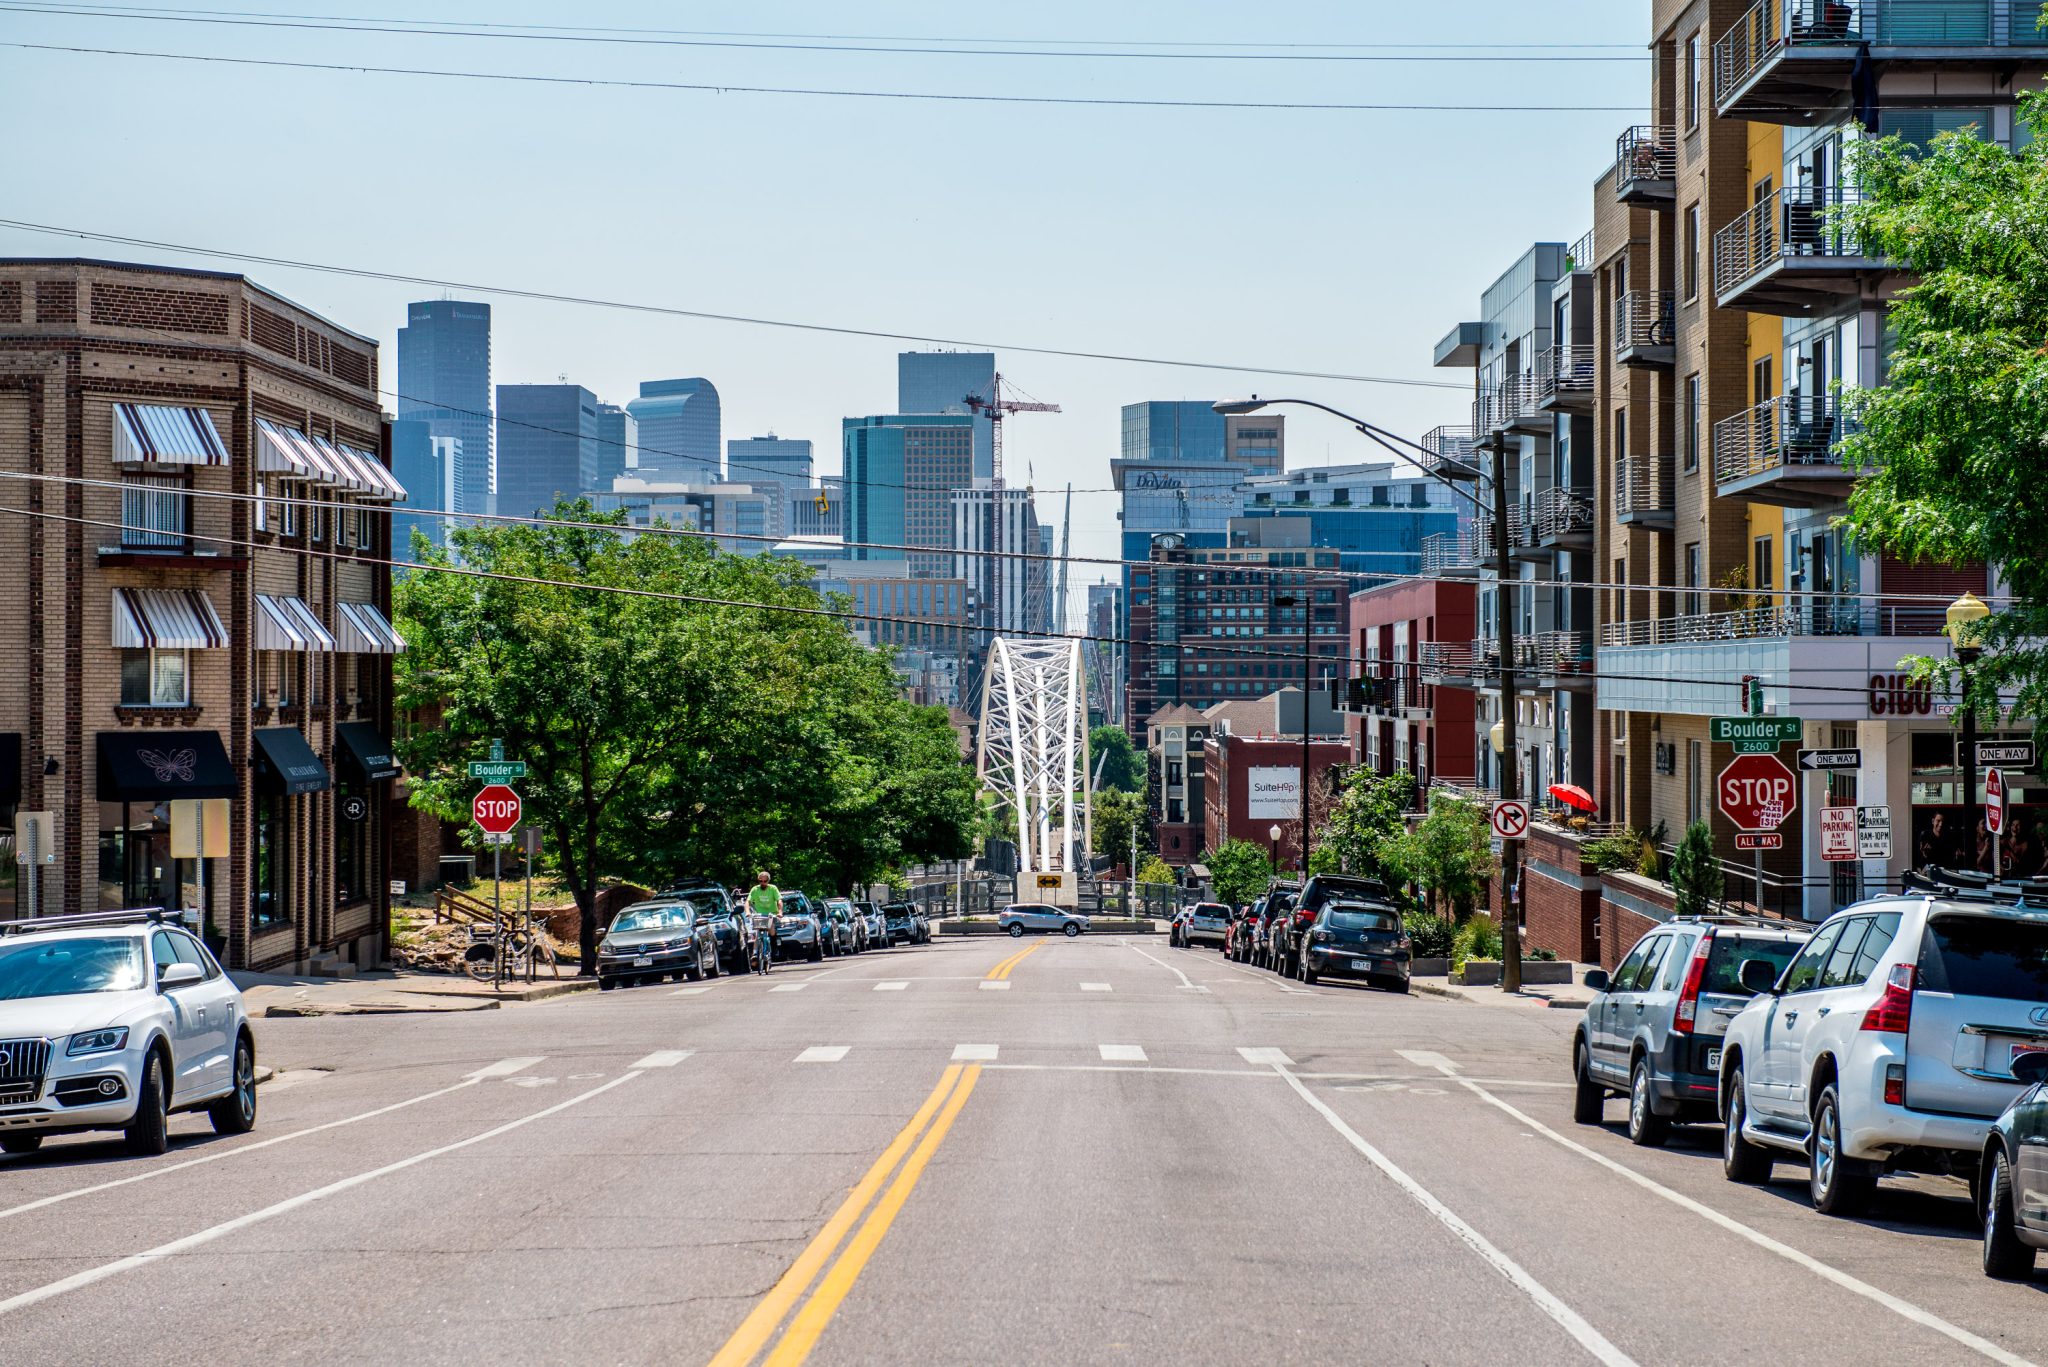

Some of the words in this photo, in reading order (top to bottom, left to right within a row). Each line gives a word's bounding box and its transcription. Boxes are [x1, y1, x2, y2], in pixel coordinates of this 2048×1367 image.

[1136, 472, 1181, 489] DaVita
[1720, 721, 1782, 738] Boulder
[1786, 723, 1796, 733] St
[1743, 742, 1770, 751] 2600
[1816, 755, 1834, 764] ONE
[1836, 754, 1854, 763] WAY
[1980, 750, 2000, 760] ONE
[2004, 748, 2026, 758] WAY
[475, 764, 512, 775] Boulder
[1725, 778, 1789, 806] STOP
[476, 800, 517, 818] STOP
[1830, 811, 1844, 820] NO
[1858, 811, 1864, 824] 2
[1872, 809, 1882, 818] HR
[1822, 822, 1853, 832] PARKING
[1866, 818, 1888, 826] PARKING
[1860, 832, 1888, 840] 8AM-10PM
[1740, 837, 1754, 846] ALL
